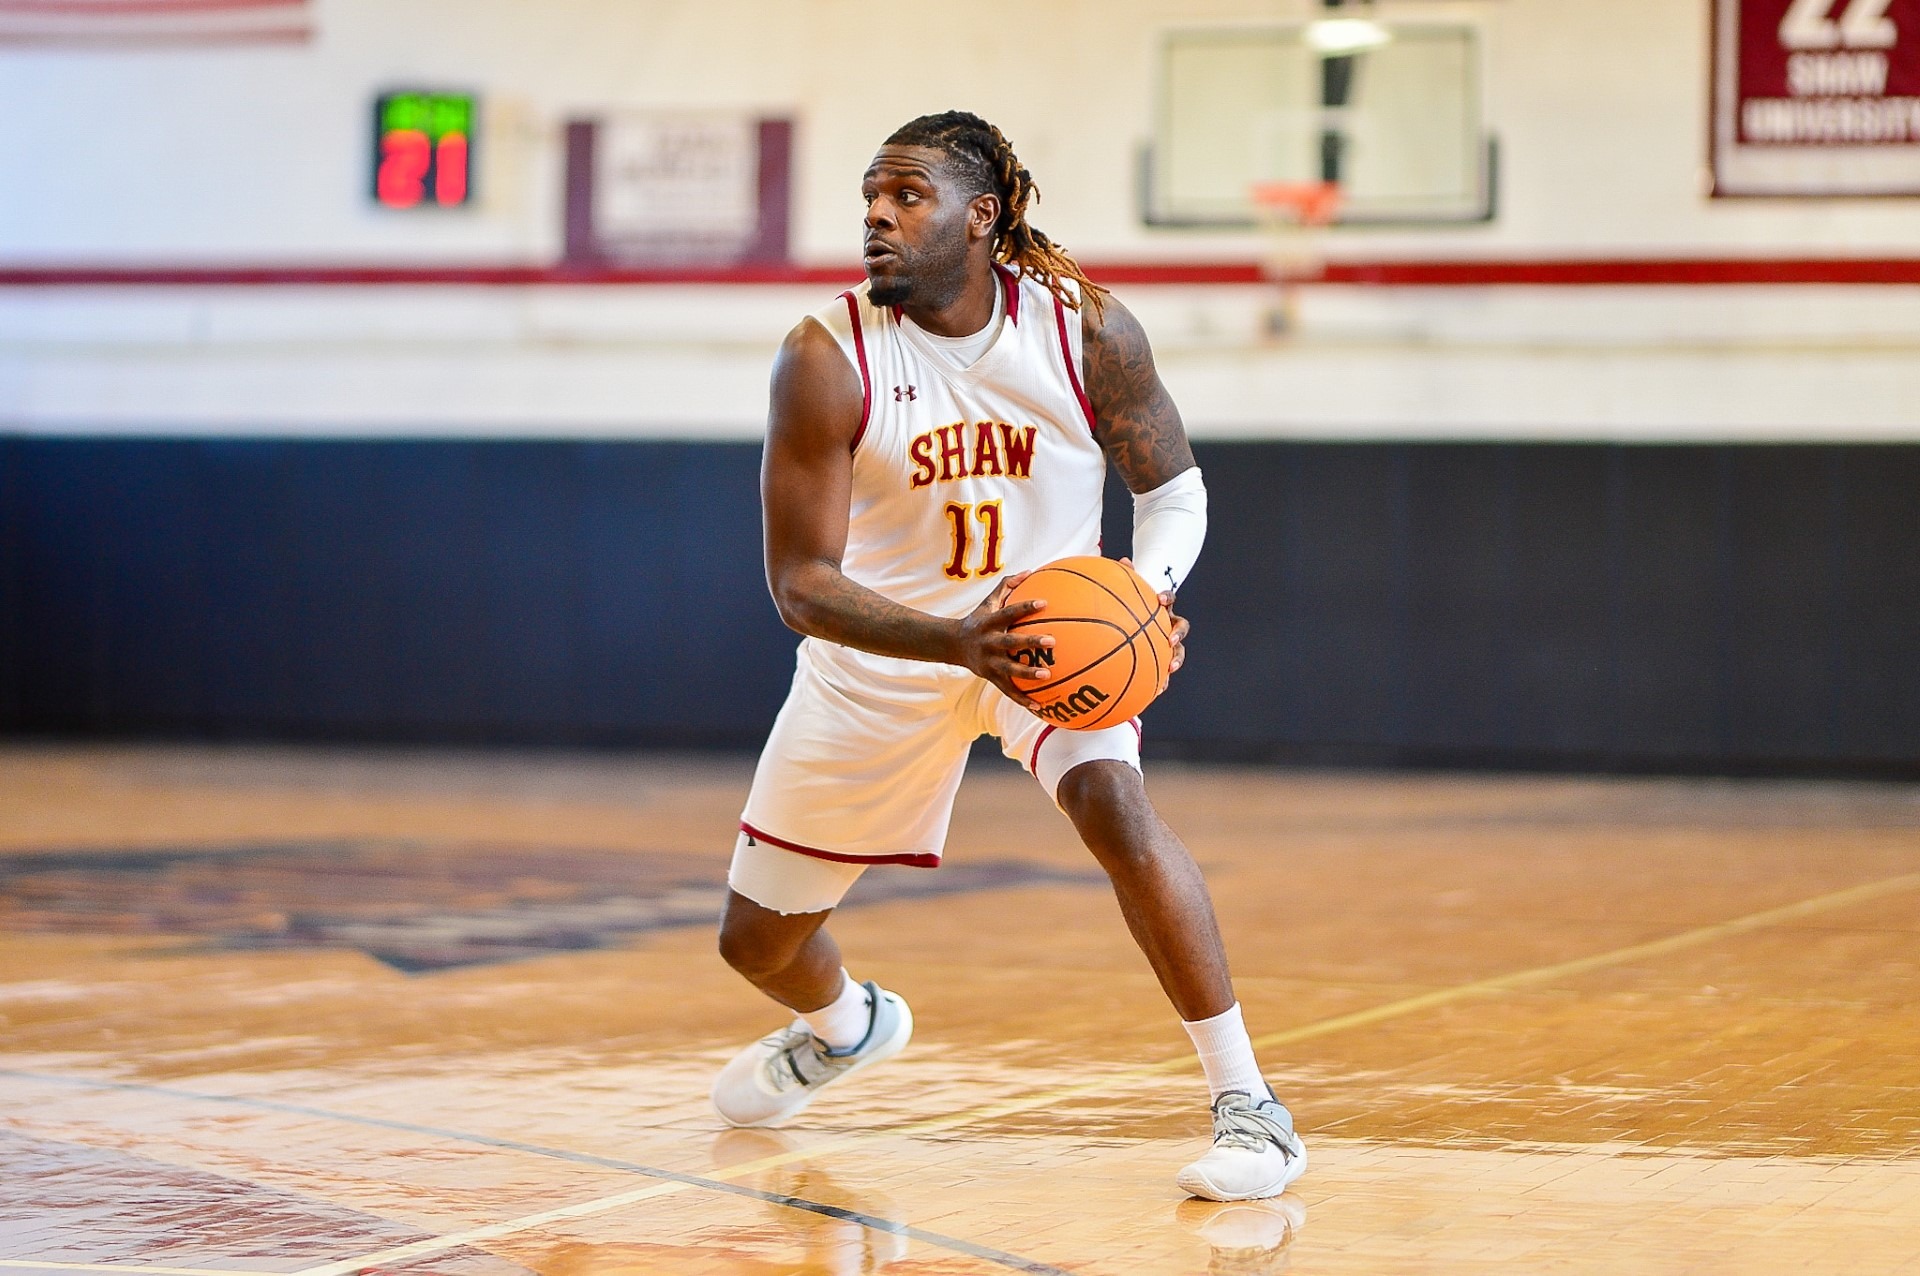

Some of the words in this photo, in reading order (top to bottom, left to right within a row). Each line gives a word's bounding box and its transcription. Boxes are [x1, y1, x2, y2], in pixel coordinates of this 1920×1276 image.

[1786, 51, 1889, 96] SHAW
[909, 419, 1038, 489] SHAW
[943, 498, 1004, 581] 11
